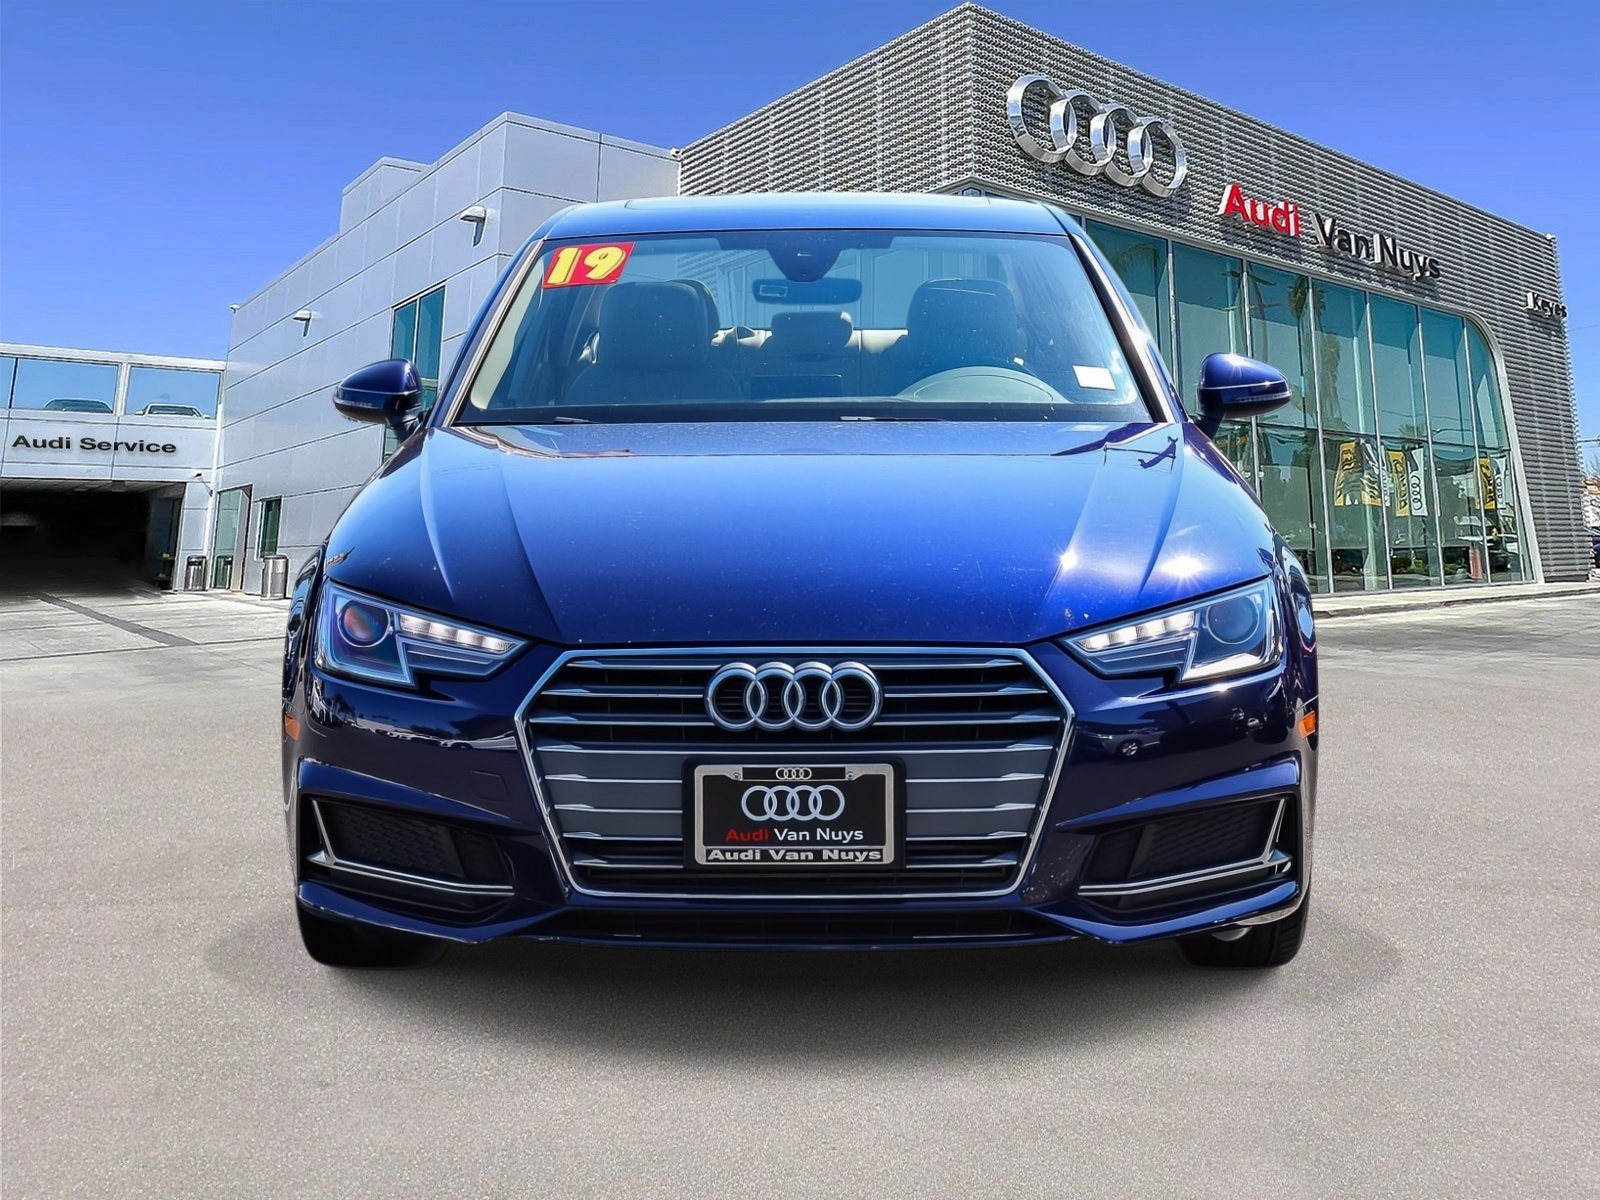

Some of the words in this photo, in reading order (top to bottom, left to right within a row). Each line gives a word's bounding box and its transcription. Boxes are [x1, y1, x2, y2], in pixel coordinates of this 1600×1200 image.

[1217, 184, 1301, 237] Audi
[1310, 213, 1370, 259] Van
[1373, 233, 1440, 280] Nuys
[546, 246, 626, 285] 19
[12, 435, 71, 450] Audi
[79, 437, 177, 453] Service
[725, 828, 769, 842] Audi
[774, 828, 810, 842] Van
[816, 827, 864, 844] Nuys
[707, 849, 761, 861] Audi
[768, 849, 814, 861] Van
[821, 849, 882, 864] Nuys
